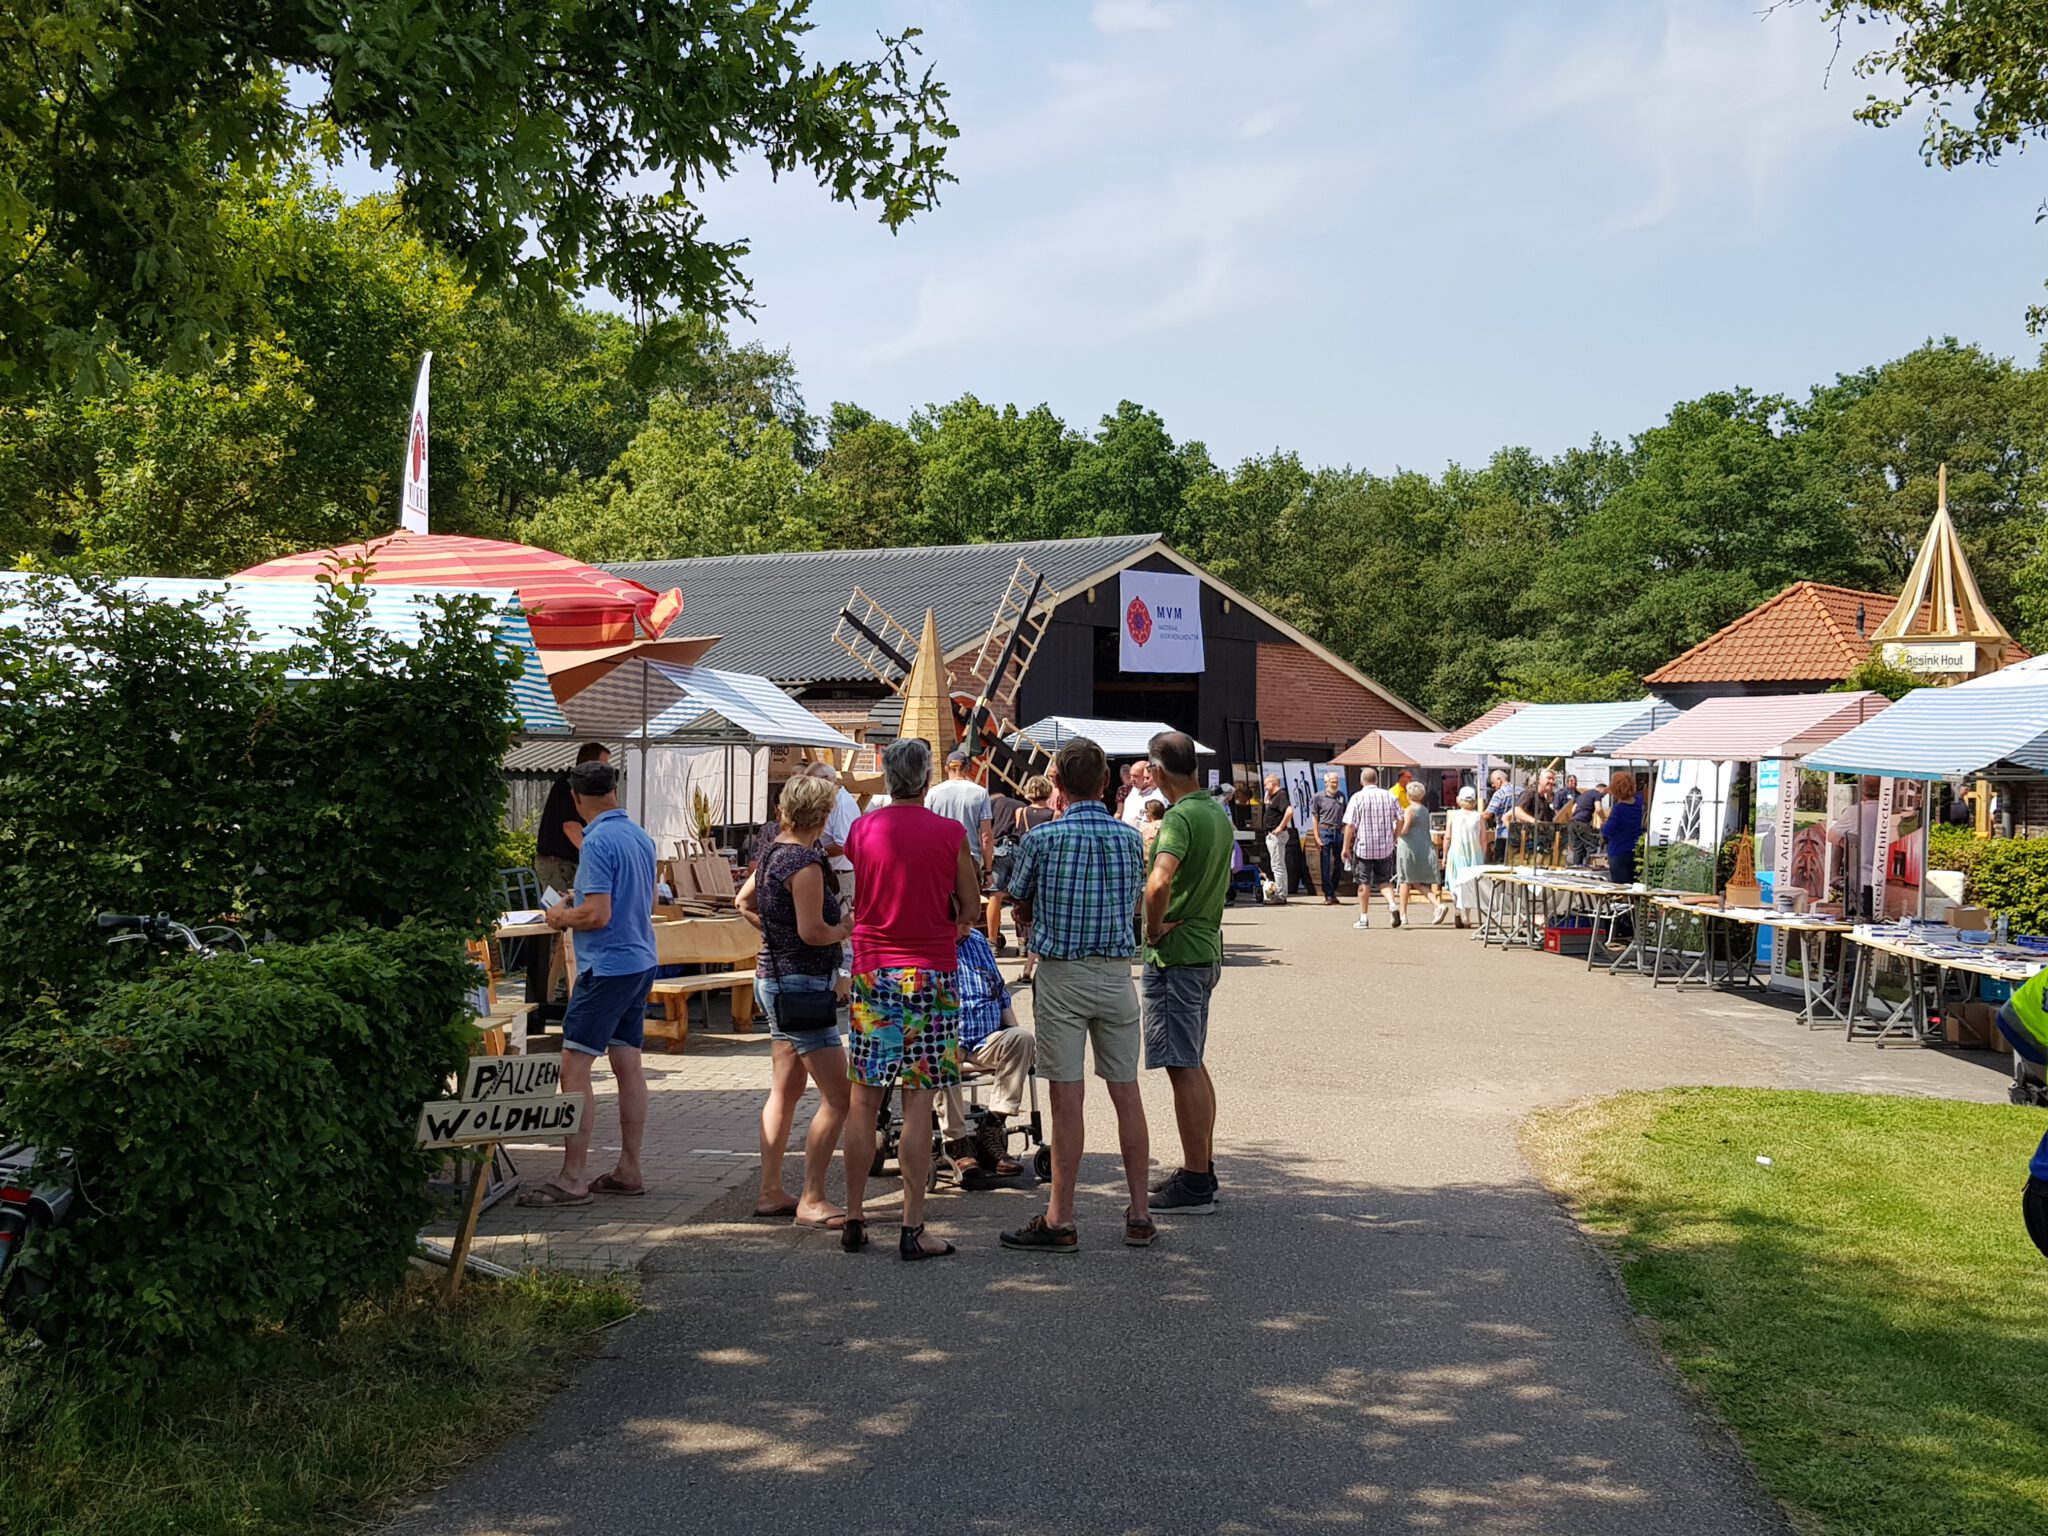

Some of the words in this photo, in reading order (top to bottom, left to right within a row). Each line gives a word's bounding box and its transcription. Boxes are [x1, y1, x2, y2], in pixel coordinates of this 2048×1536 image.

[1157, 605, 1182, 620] MVM
[1905, 654, 1939, 666] Assink
[1941, 654, 1963, 666] Hout
[1780, 780, 1792, 860] Architecten
[1877, 787, 1890, 873] Architecten
[427, 1101, 576, 1141] WOLDHUIS
